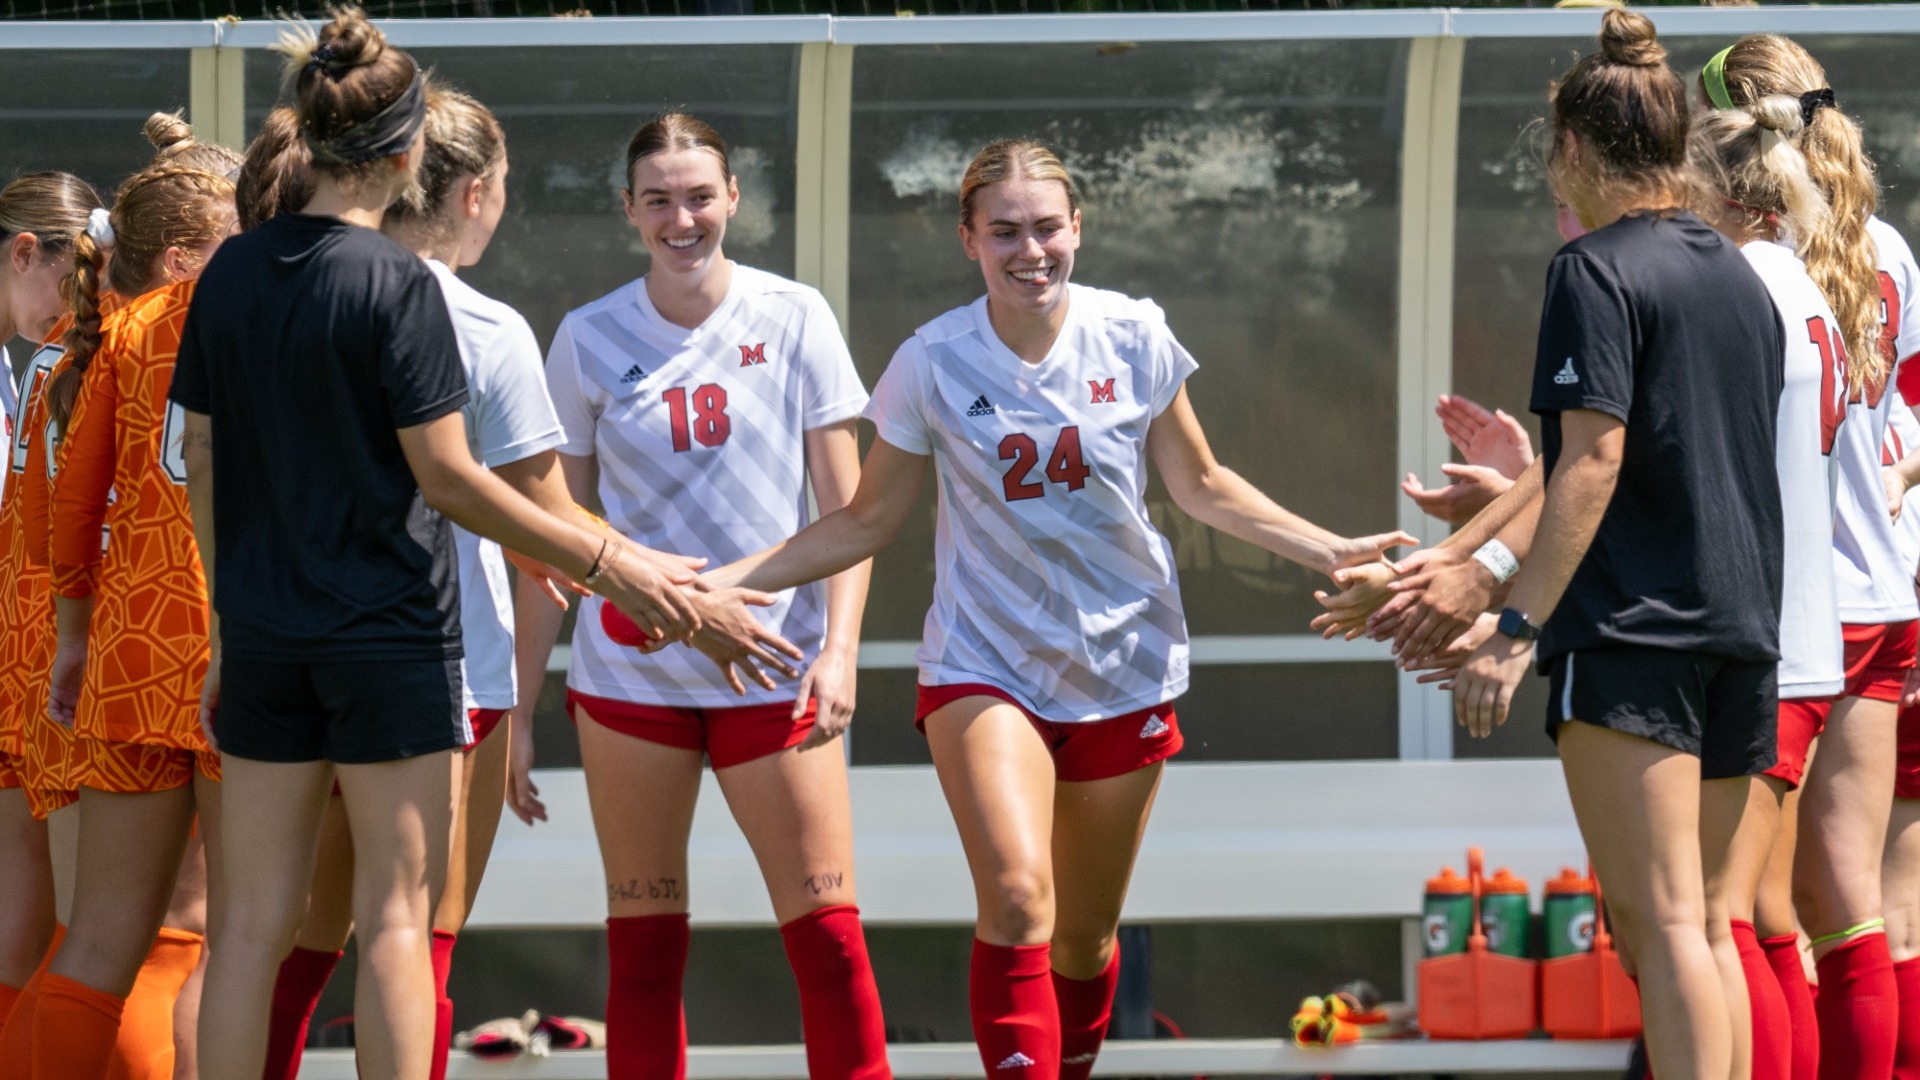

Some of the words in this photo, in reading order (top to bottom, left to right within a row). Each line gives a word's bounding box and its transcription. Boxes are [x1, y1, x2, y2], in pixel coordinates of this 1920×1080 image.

[738, 342, 768, 367] M
[1087, 378, 1117, 404] M
[662, 383, 731, 453] 18
[967, 407, 995, 417] adidas
[997, 425, 1090, 502] 24
